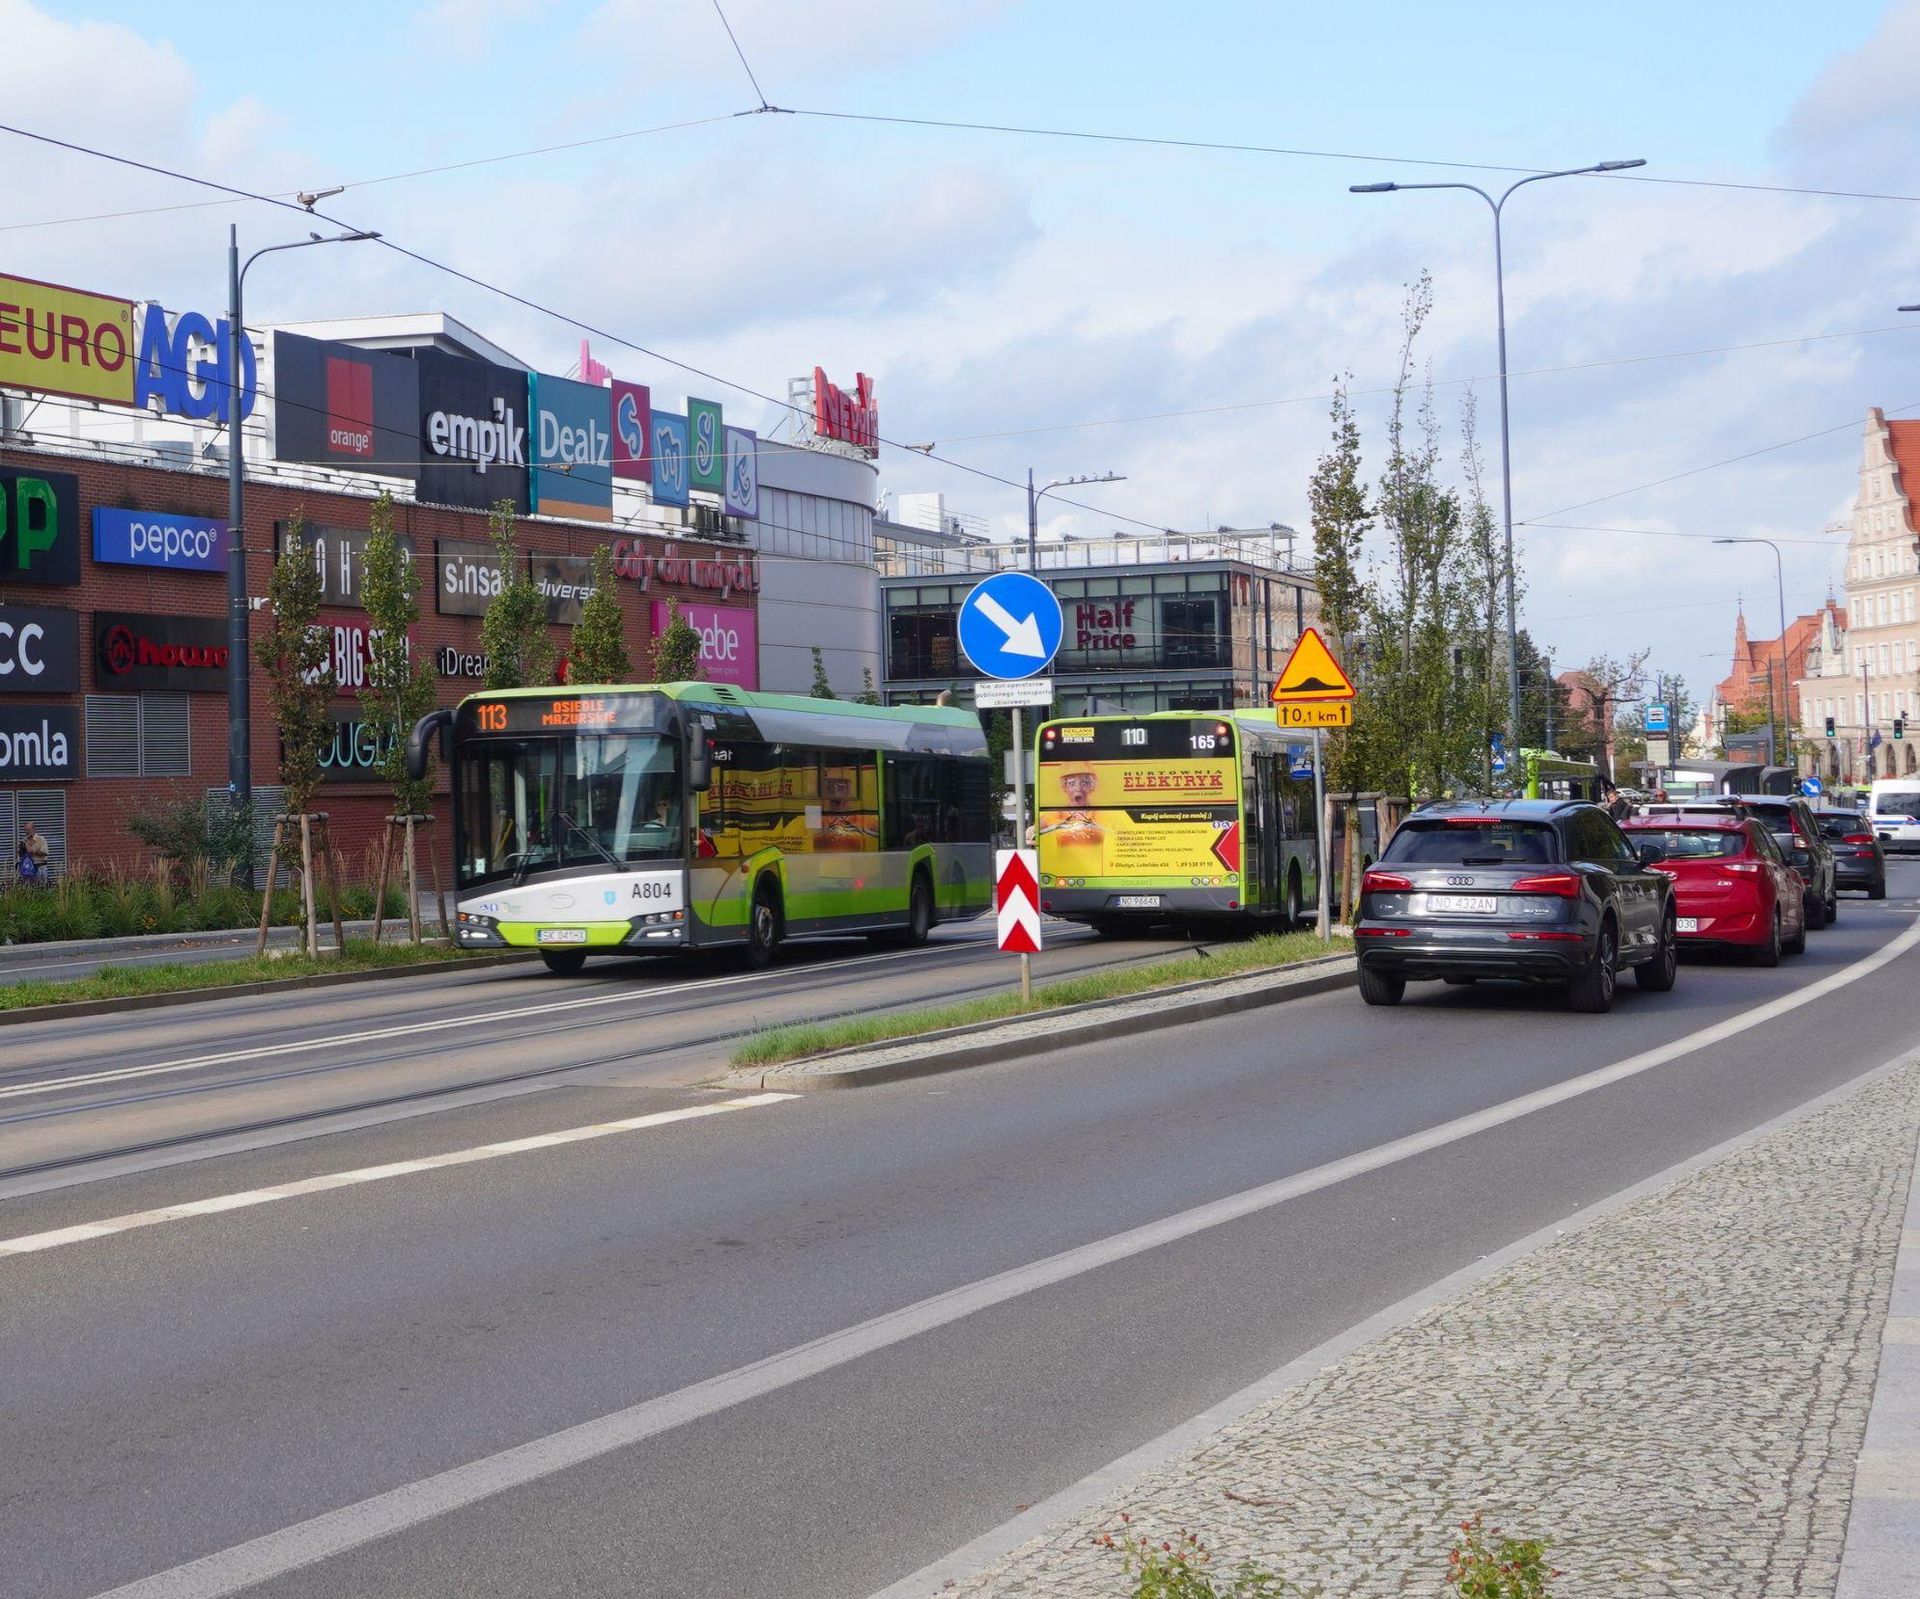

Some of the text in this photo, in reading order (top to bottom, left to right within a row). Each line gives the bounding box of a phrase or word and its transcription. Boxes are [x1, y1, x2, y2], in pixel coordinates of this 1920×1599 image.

[0, 302, 126, 372] EURO
[136, 304, 258, 424] AGD
[330, 429, 369, 449] orange
[426, 397, 526, 473] empik
[539, 409, 609, 468] Dealz
[130, 522, 209, 562] pepco
[1076, 600, 1135, 629] Half
[1077, 630, 1136, 650] Price
[335, 626, 363, 686] BIG
[553, 700, 605, 712] OSIEDLE
[1292, 708, 1337, 723] 0,1 km
[478, 704, 507, 730] 113
[542, 712, 617, 725] MAZURSKIE
[1124, 728, 1145, 745] 110
[1190, 735, 1215, 749] 165
[1123, 774, 1222, 787] ELEKTRYK
[632, 883, 671, 899] A804
[1435, 897, 1493, 910] NO 432AN
[1677, 919, 1696, 929] 030
